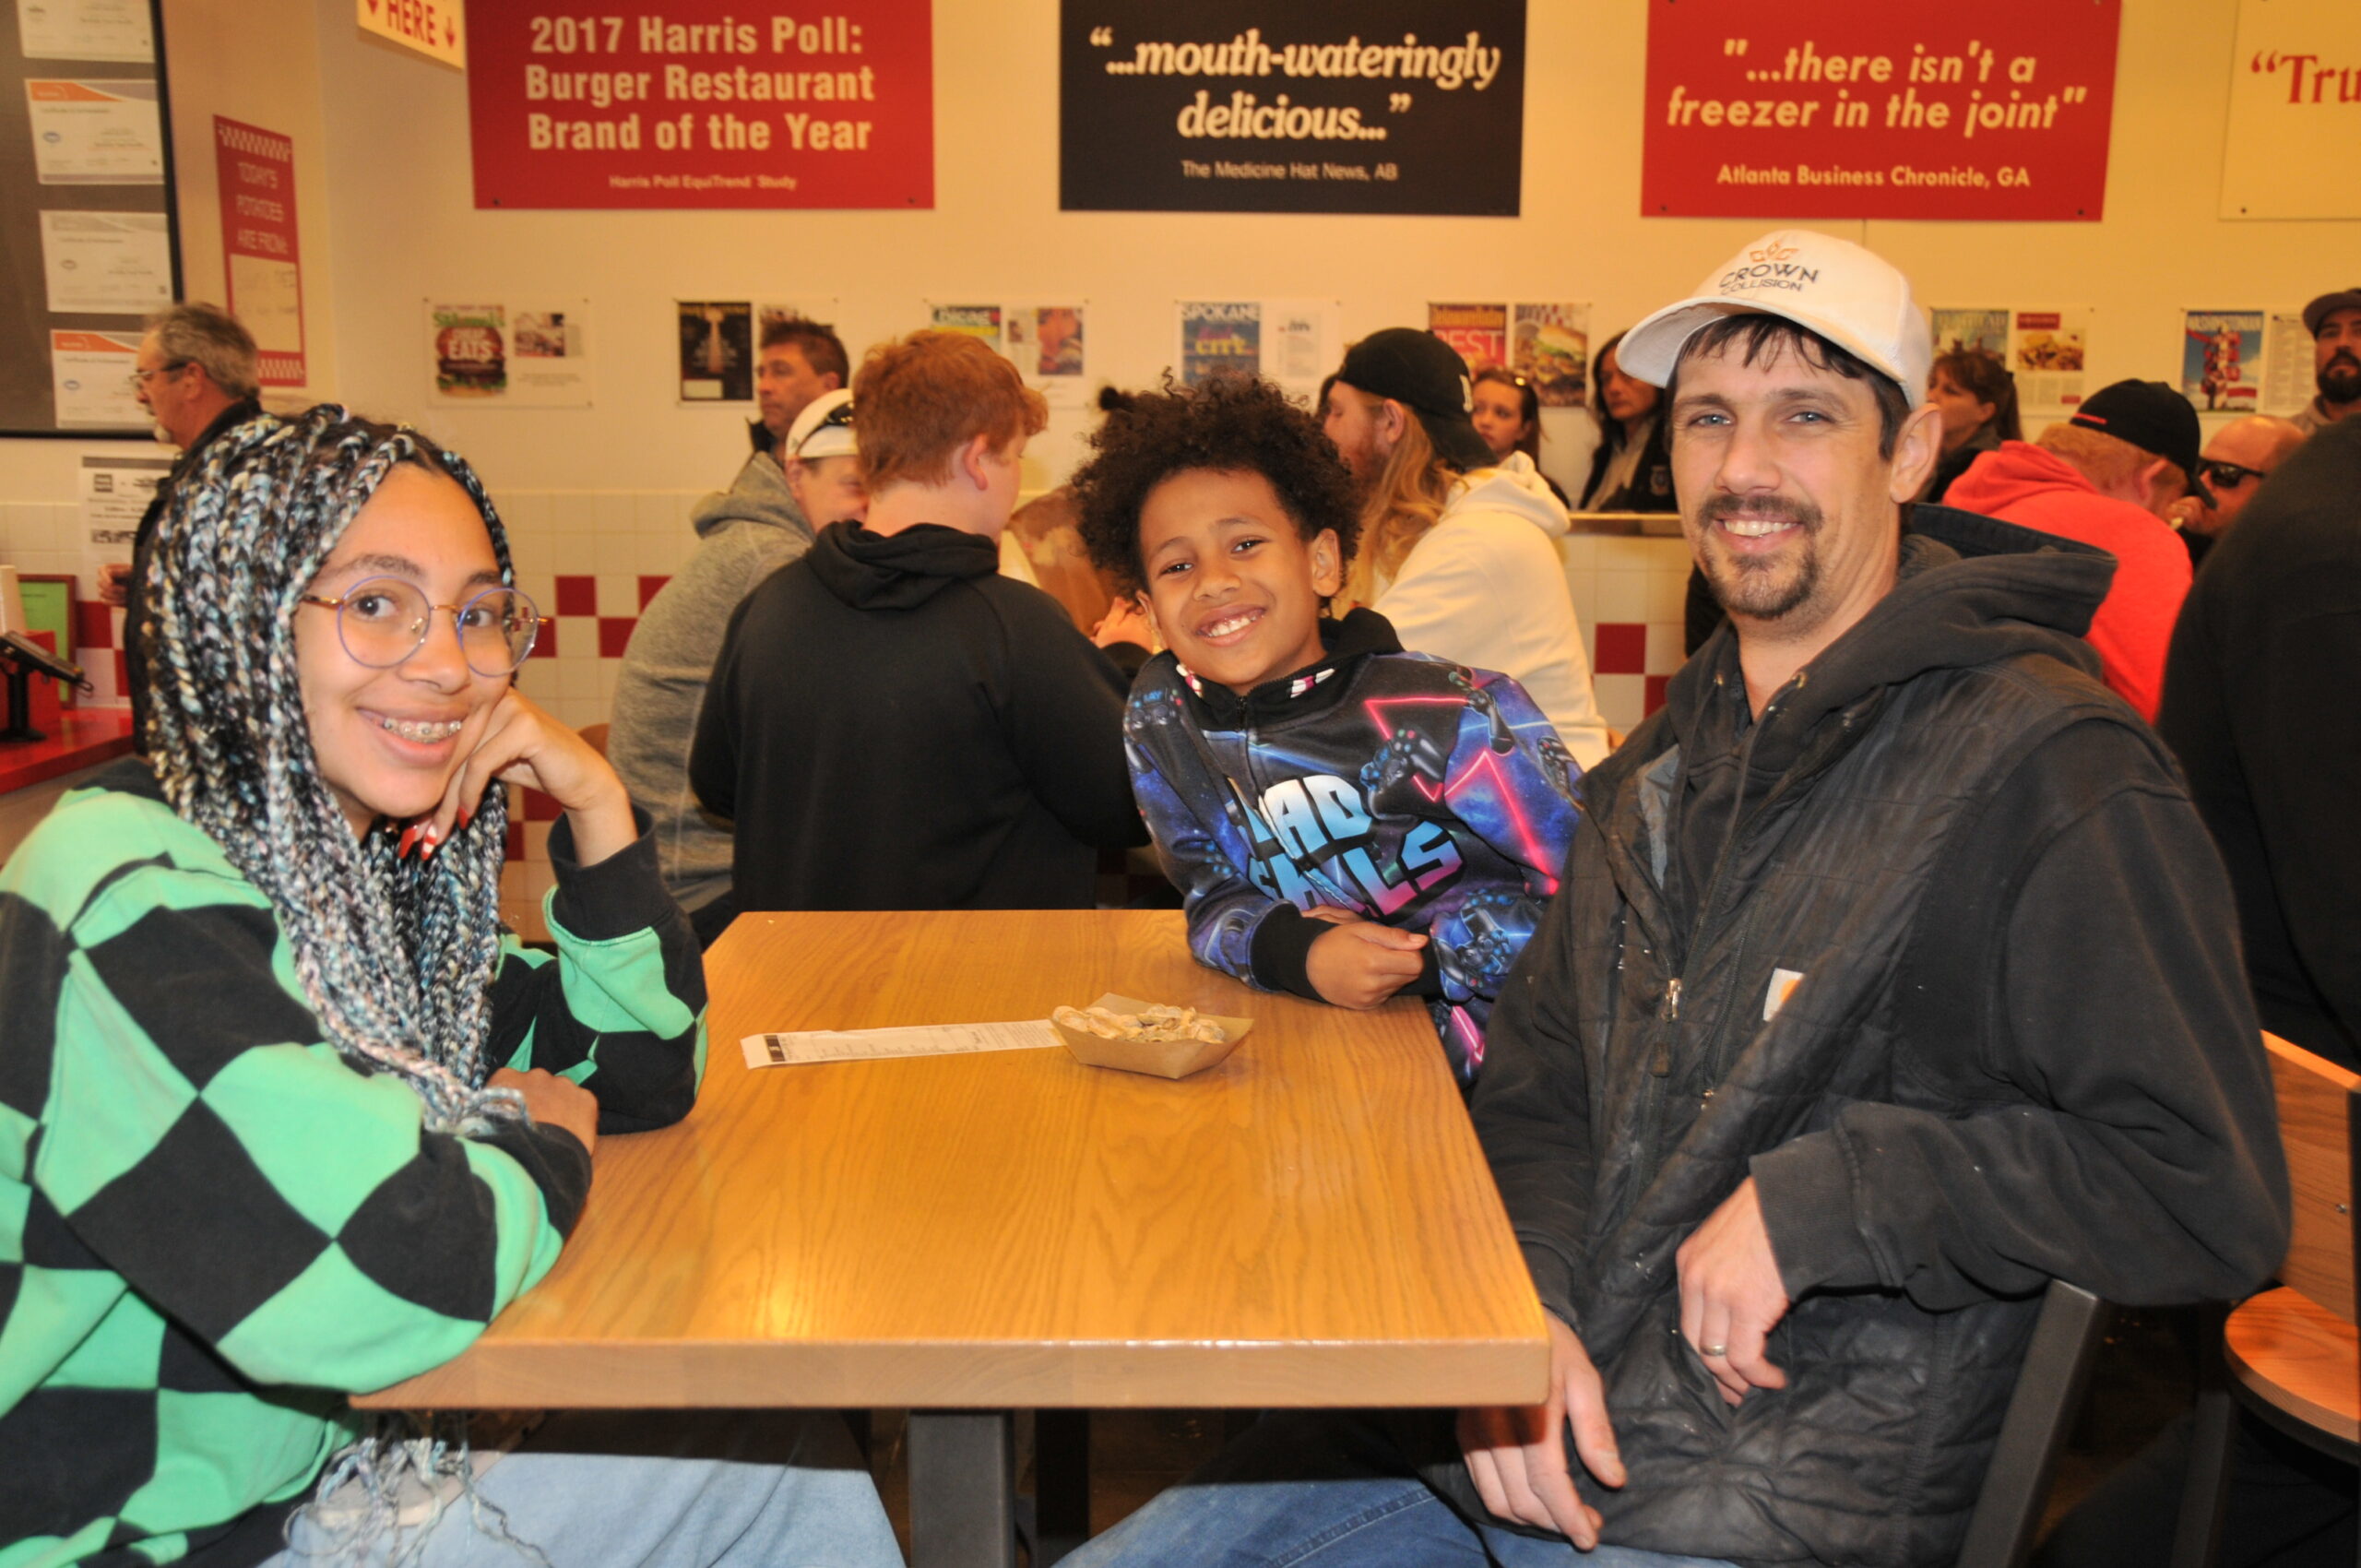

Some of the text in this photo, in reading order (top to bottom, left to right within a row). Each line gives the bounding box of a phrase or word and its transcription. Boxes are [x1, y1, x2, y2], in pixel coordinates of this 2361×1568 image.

[386, 0, 437, 47] HERE
[530, 17, 863, 54] 2017 Harris Poll:
[1908, 40, 1993, 83] isn't
[2008, 55, 2036, 83] a
[525, 65, 875, 108] Burger Restaurant
[1667, 86, 2088, 138] freezer in the joint"
[528, 113, 872, 150] Brand of the Year
[609, 174, 650, 188] Harris
[653, 174, 680, 188] Poll
[756, 174, 797, 191] Study
[1181, 160, 1398, 181] The Medicine Hat News, AB
[1716, 164, 2032, 189] Atlanta Business Chronicle, GA
[1719, 264, 1821, 289] CROWN
[1721, 279, 1807, 296] COLLISION
[448, 340, 493, 362] EATS
